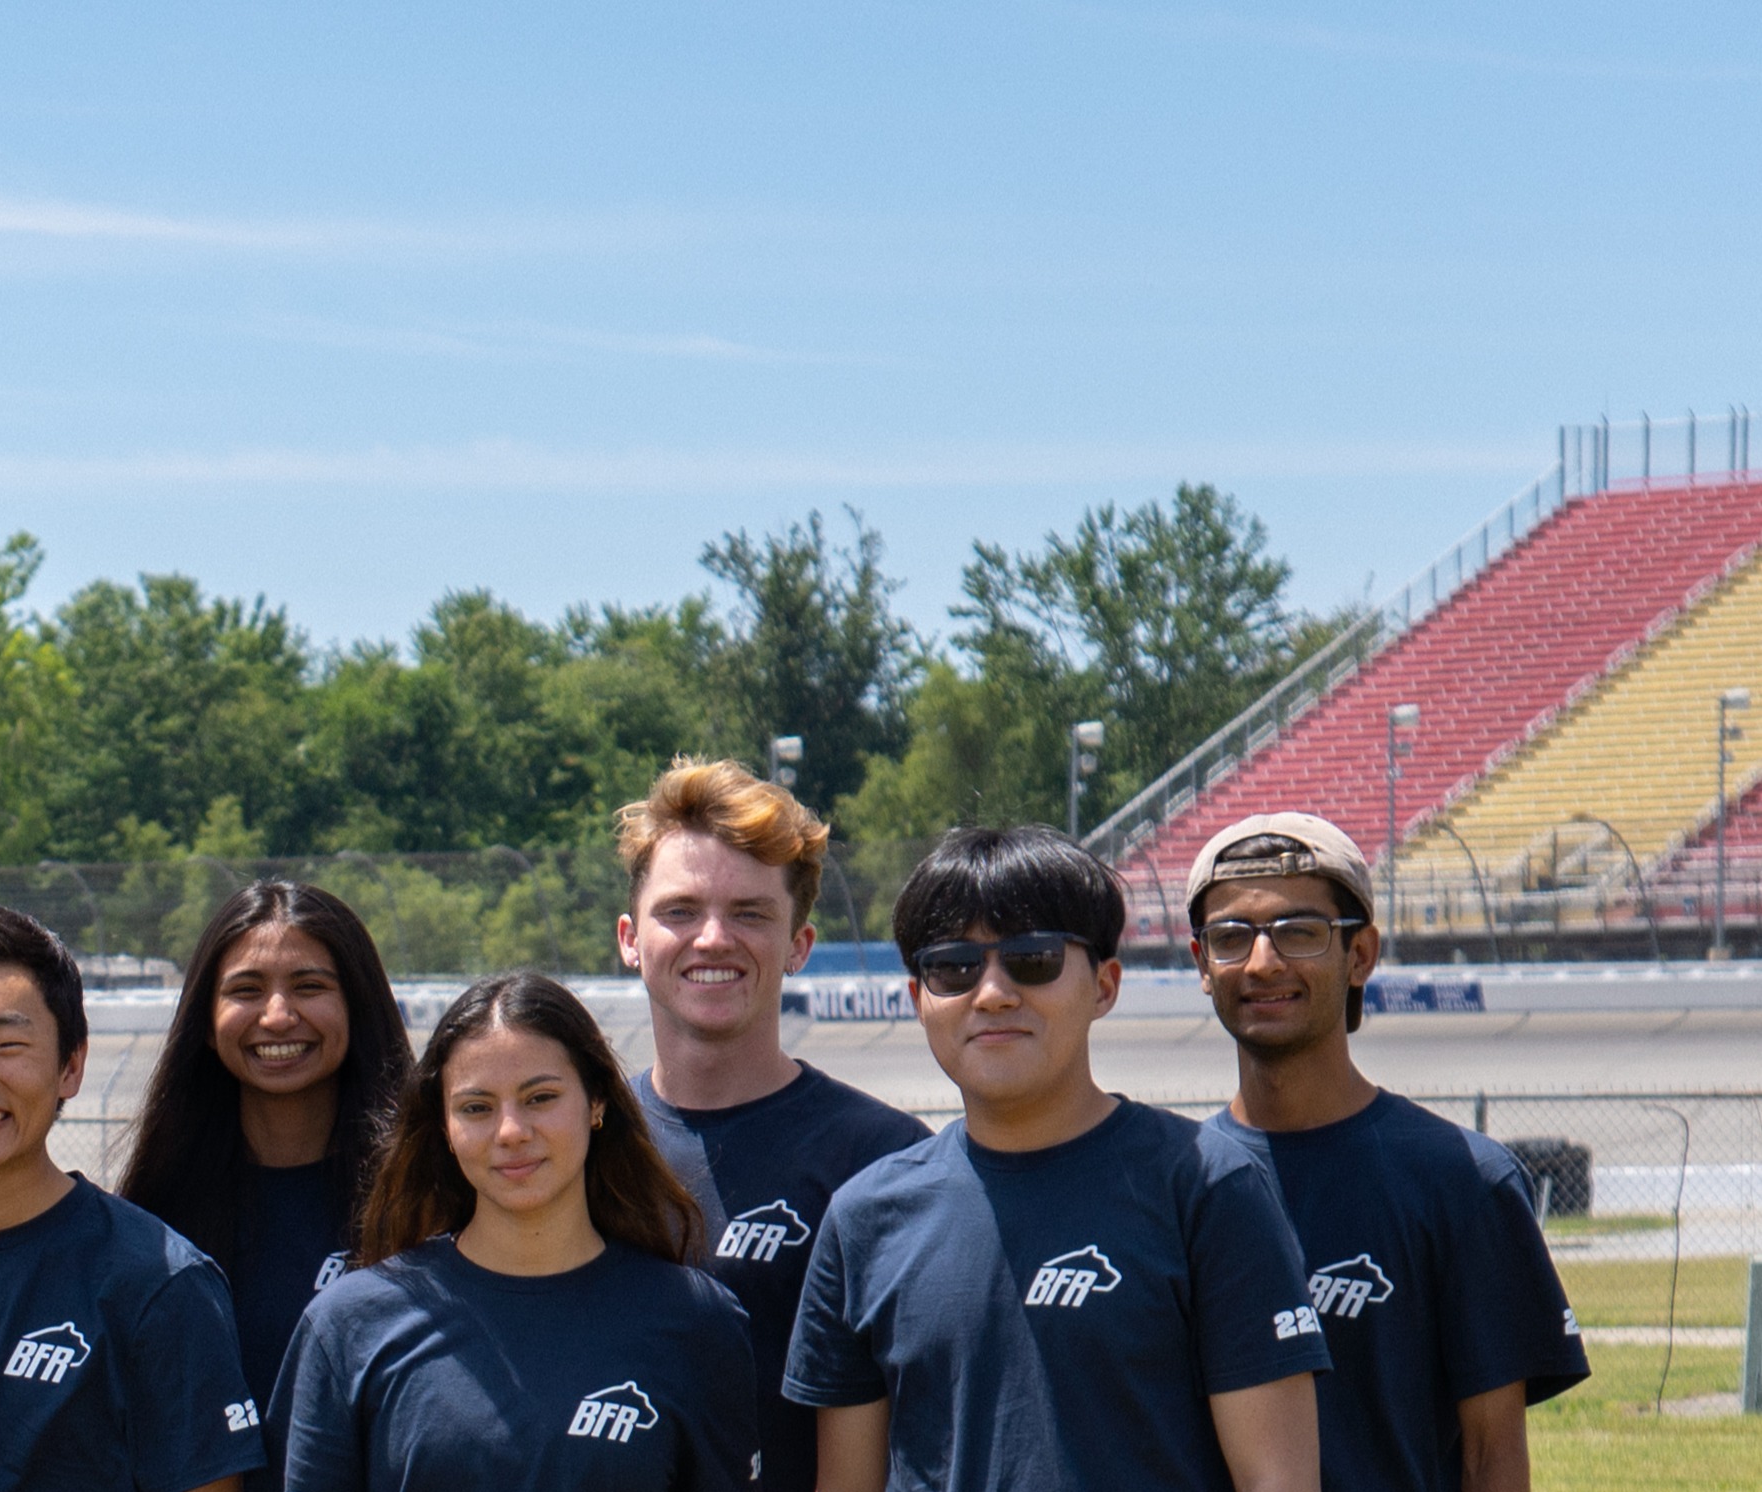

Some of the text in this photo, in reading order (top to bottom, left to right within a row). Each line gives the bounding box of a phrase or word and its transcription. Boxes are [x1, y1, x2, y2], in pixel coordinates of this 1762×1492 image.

[716, 1221, 788, 1262] BFR
[1024, 1267, 1098, 1308] BFR
[1273, 1305, 1323, 1340] 22
[3, 1339, 76, 1384] BFR
[567, 1399, 640, 1443] BFR
